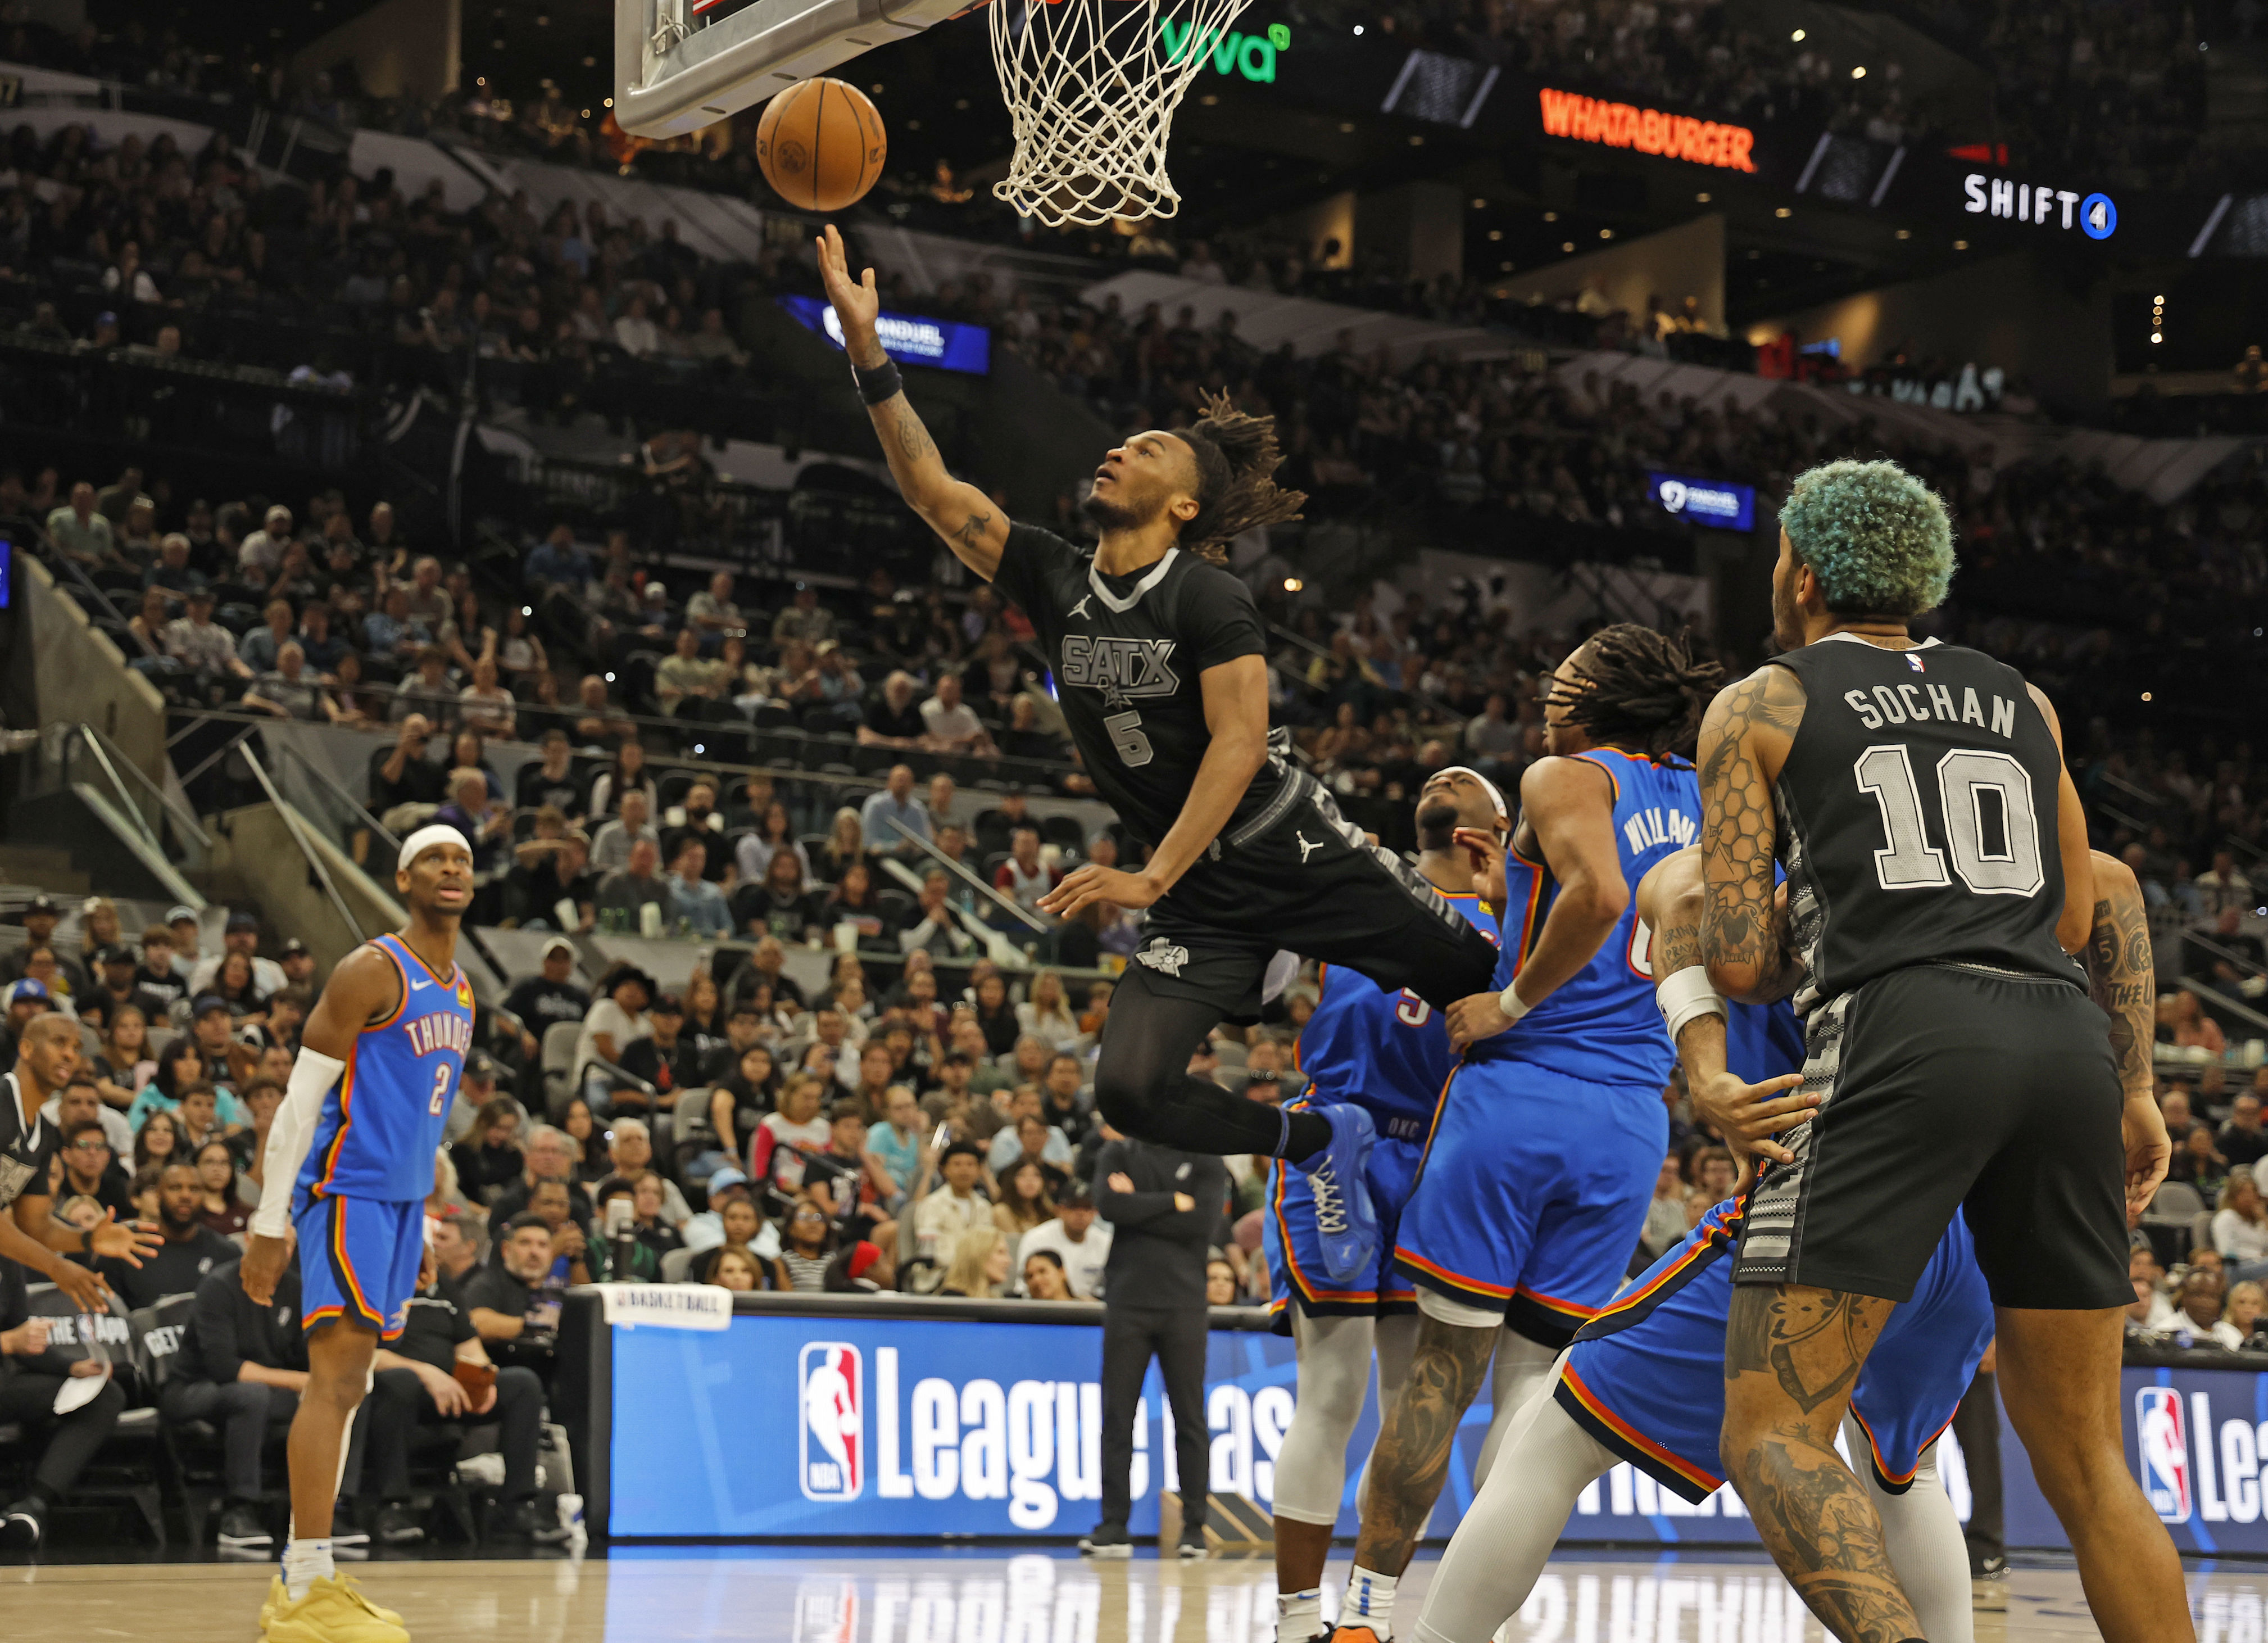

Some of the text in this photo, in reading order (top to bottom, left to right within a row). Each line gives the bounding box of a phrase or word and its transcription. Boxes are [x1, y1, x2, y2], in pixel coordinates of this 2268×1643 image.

[1159, 16, 1276, 83] viva
[1539, 87, 1755, 173] WHATABURGER
[1062, 635, 1180, 698] SATX
[1104, 710, 1154, 768] 5
[1844, 684, 2015, 739] SOCHAN
[1854, 744, 2045, 898] 10
[428, 1062, 452, 1117] 2
[2190, 1391, 2268, 1524] Le
